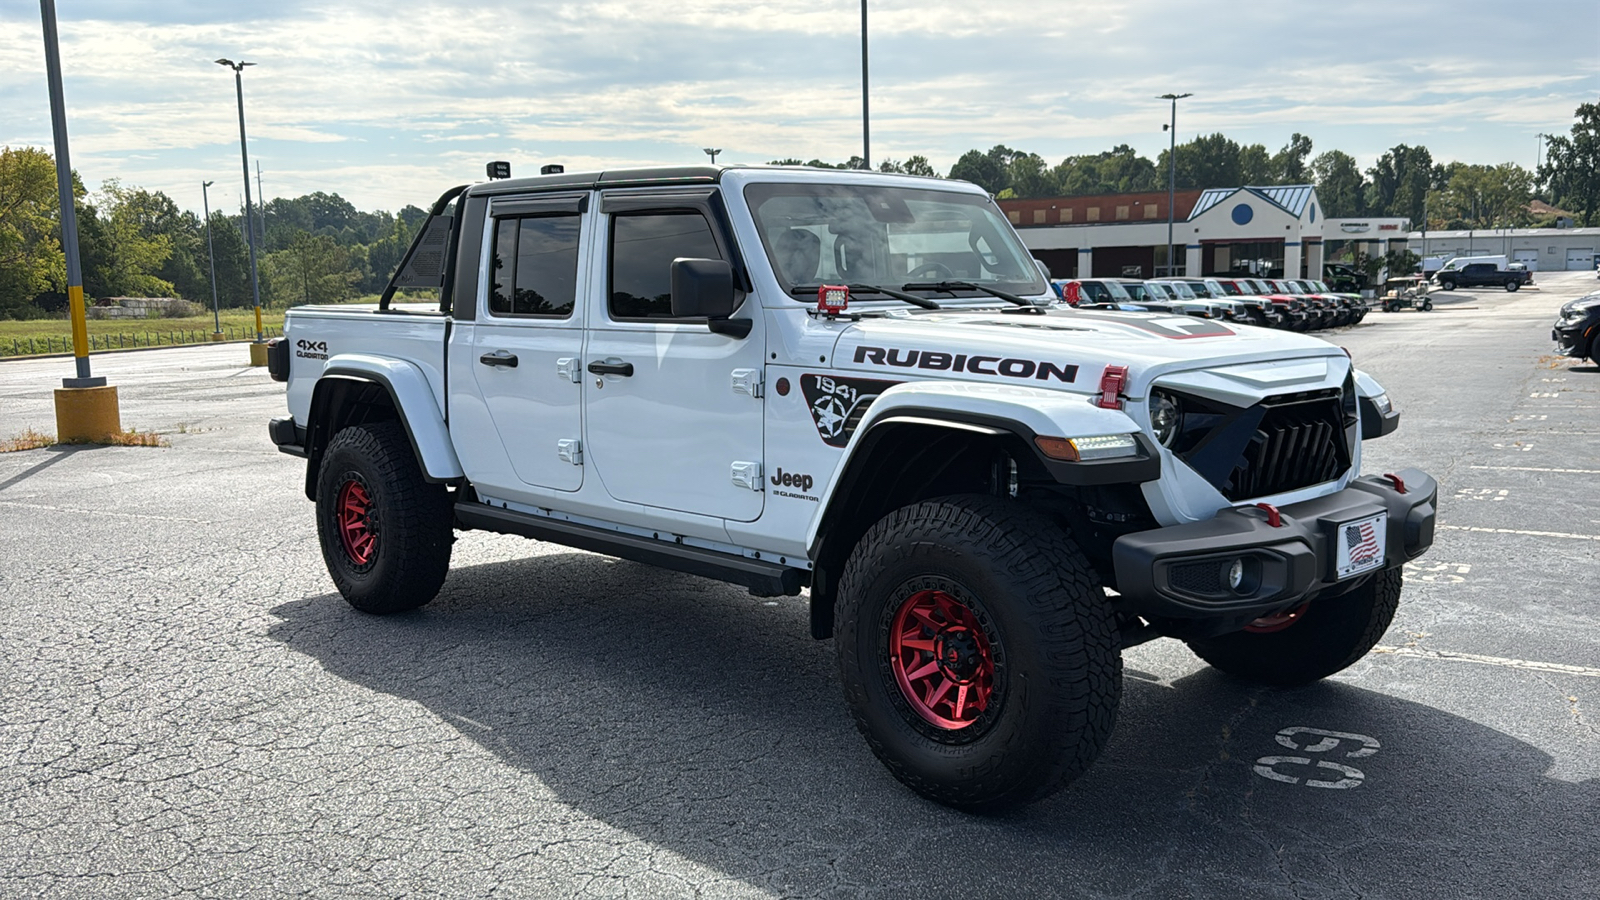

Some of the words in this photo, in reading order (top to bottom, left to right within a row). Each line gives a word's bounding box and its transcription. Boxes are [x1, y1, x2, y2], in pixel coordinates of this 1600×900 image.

[296, 350, 329, 360] GLADIATOR
[853, 345, 1080, 383] RUBICON
[814, 375, 857, 402] 1941
[771, 467, 814, 492] Jeep
[779, 490, 820, 502] GLADIATOR
